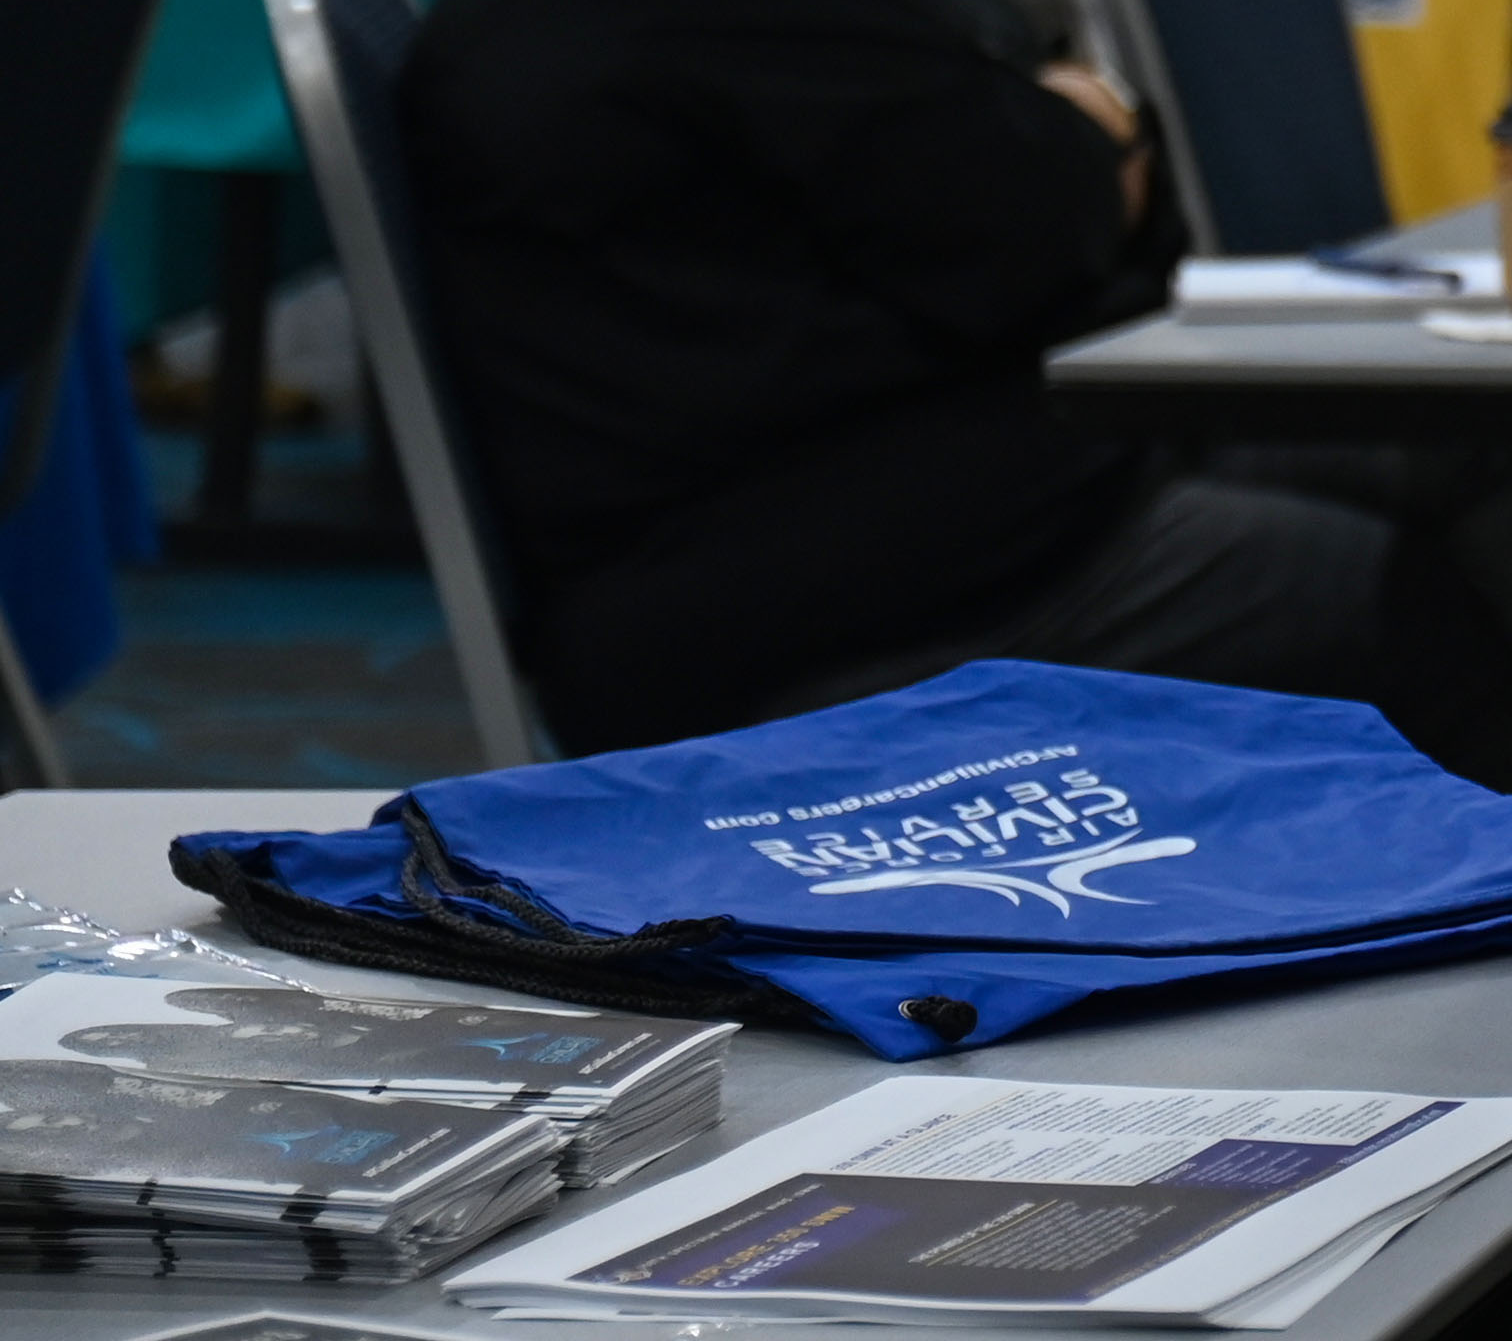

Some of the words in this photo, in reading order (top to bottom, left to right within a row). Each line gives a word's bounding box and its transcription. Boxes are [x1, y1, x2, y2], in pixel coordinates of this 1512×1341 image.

[751, 768, 1101, 856] SERVICE
[769, 787, 1128, 870] CIVILIAN
[1043, 806, 1139, 847] AIR
[795, 843, 1007, 877] FORCE
[714, 1240, 820, 1288] CAREERS
